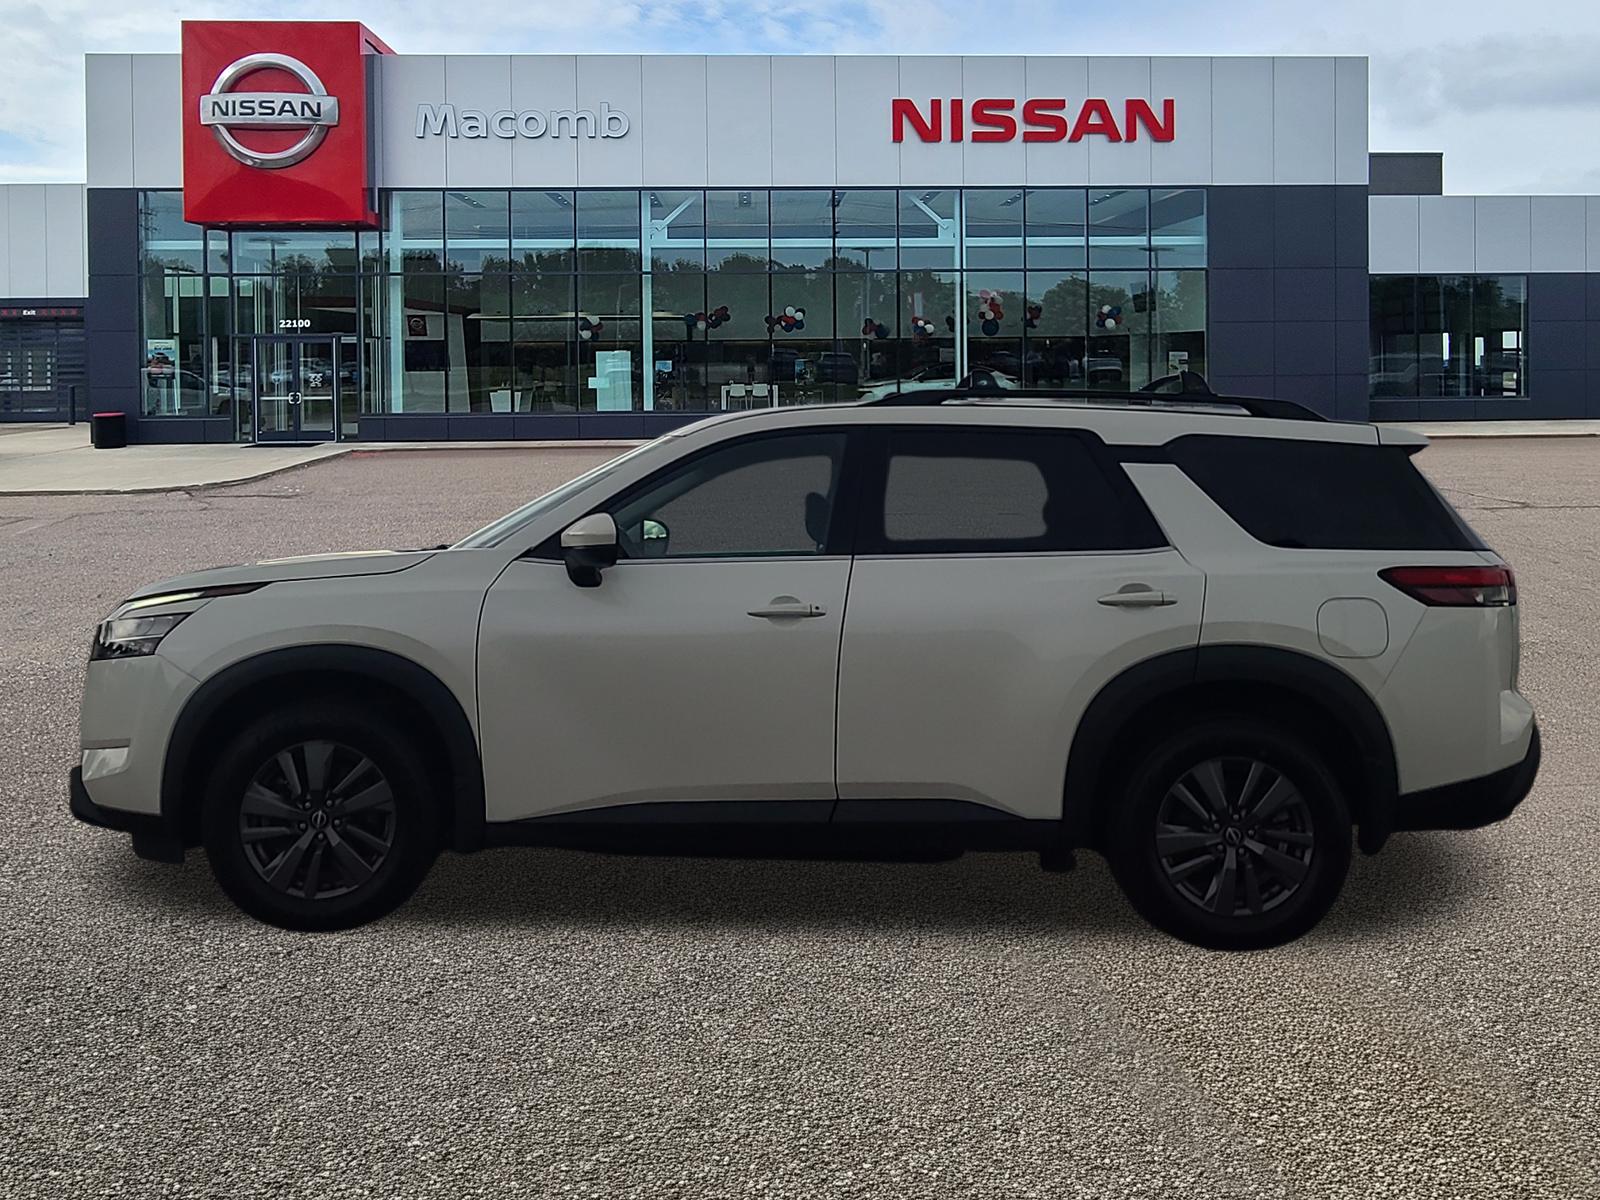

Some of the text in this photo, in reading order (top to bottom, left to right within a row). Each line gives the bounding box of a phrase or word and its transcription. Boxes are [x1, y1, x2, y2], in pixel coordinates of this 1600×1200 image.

[212, 100, 321, 117] NISSAN
[415, 102, 630, 138] Macomb
[892, 99, 1175, 142] NISSAN
[279, 319, 311, 328] 22100
